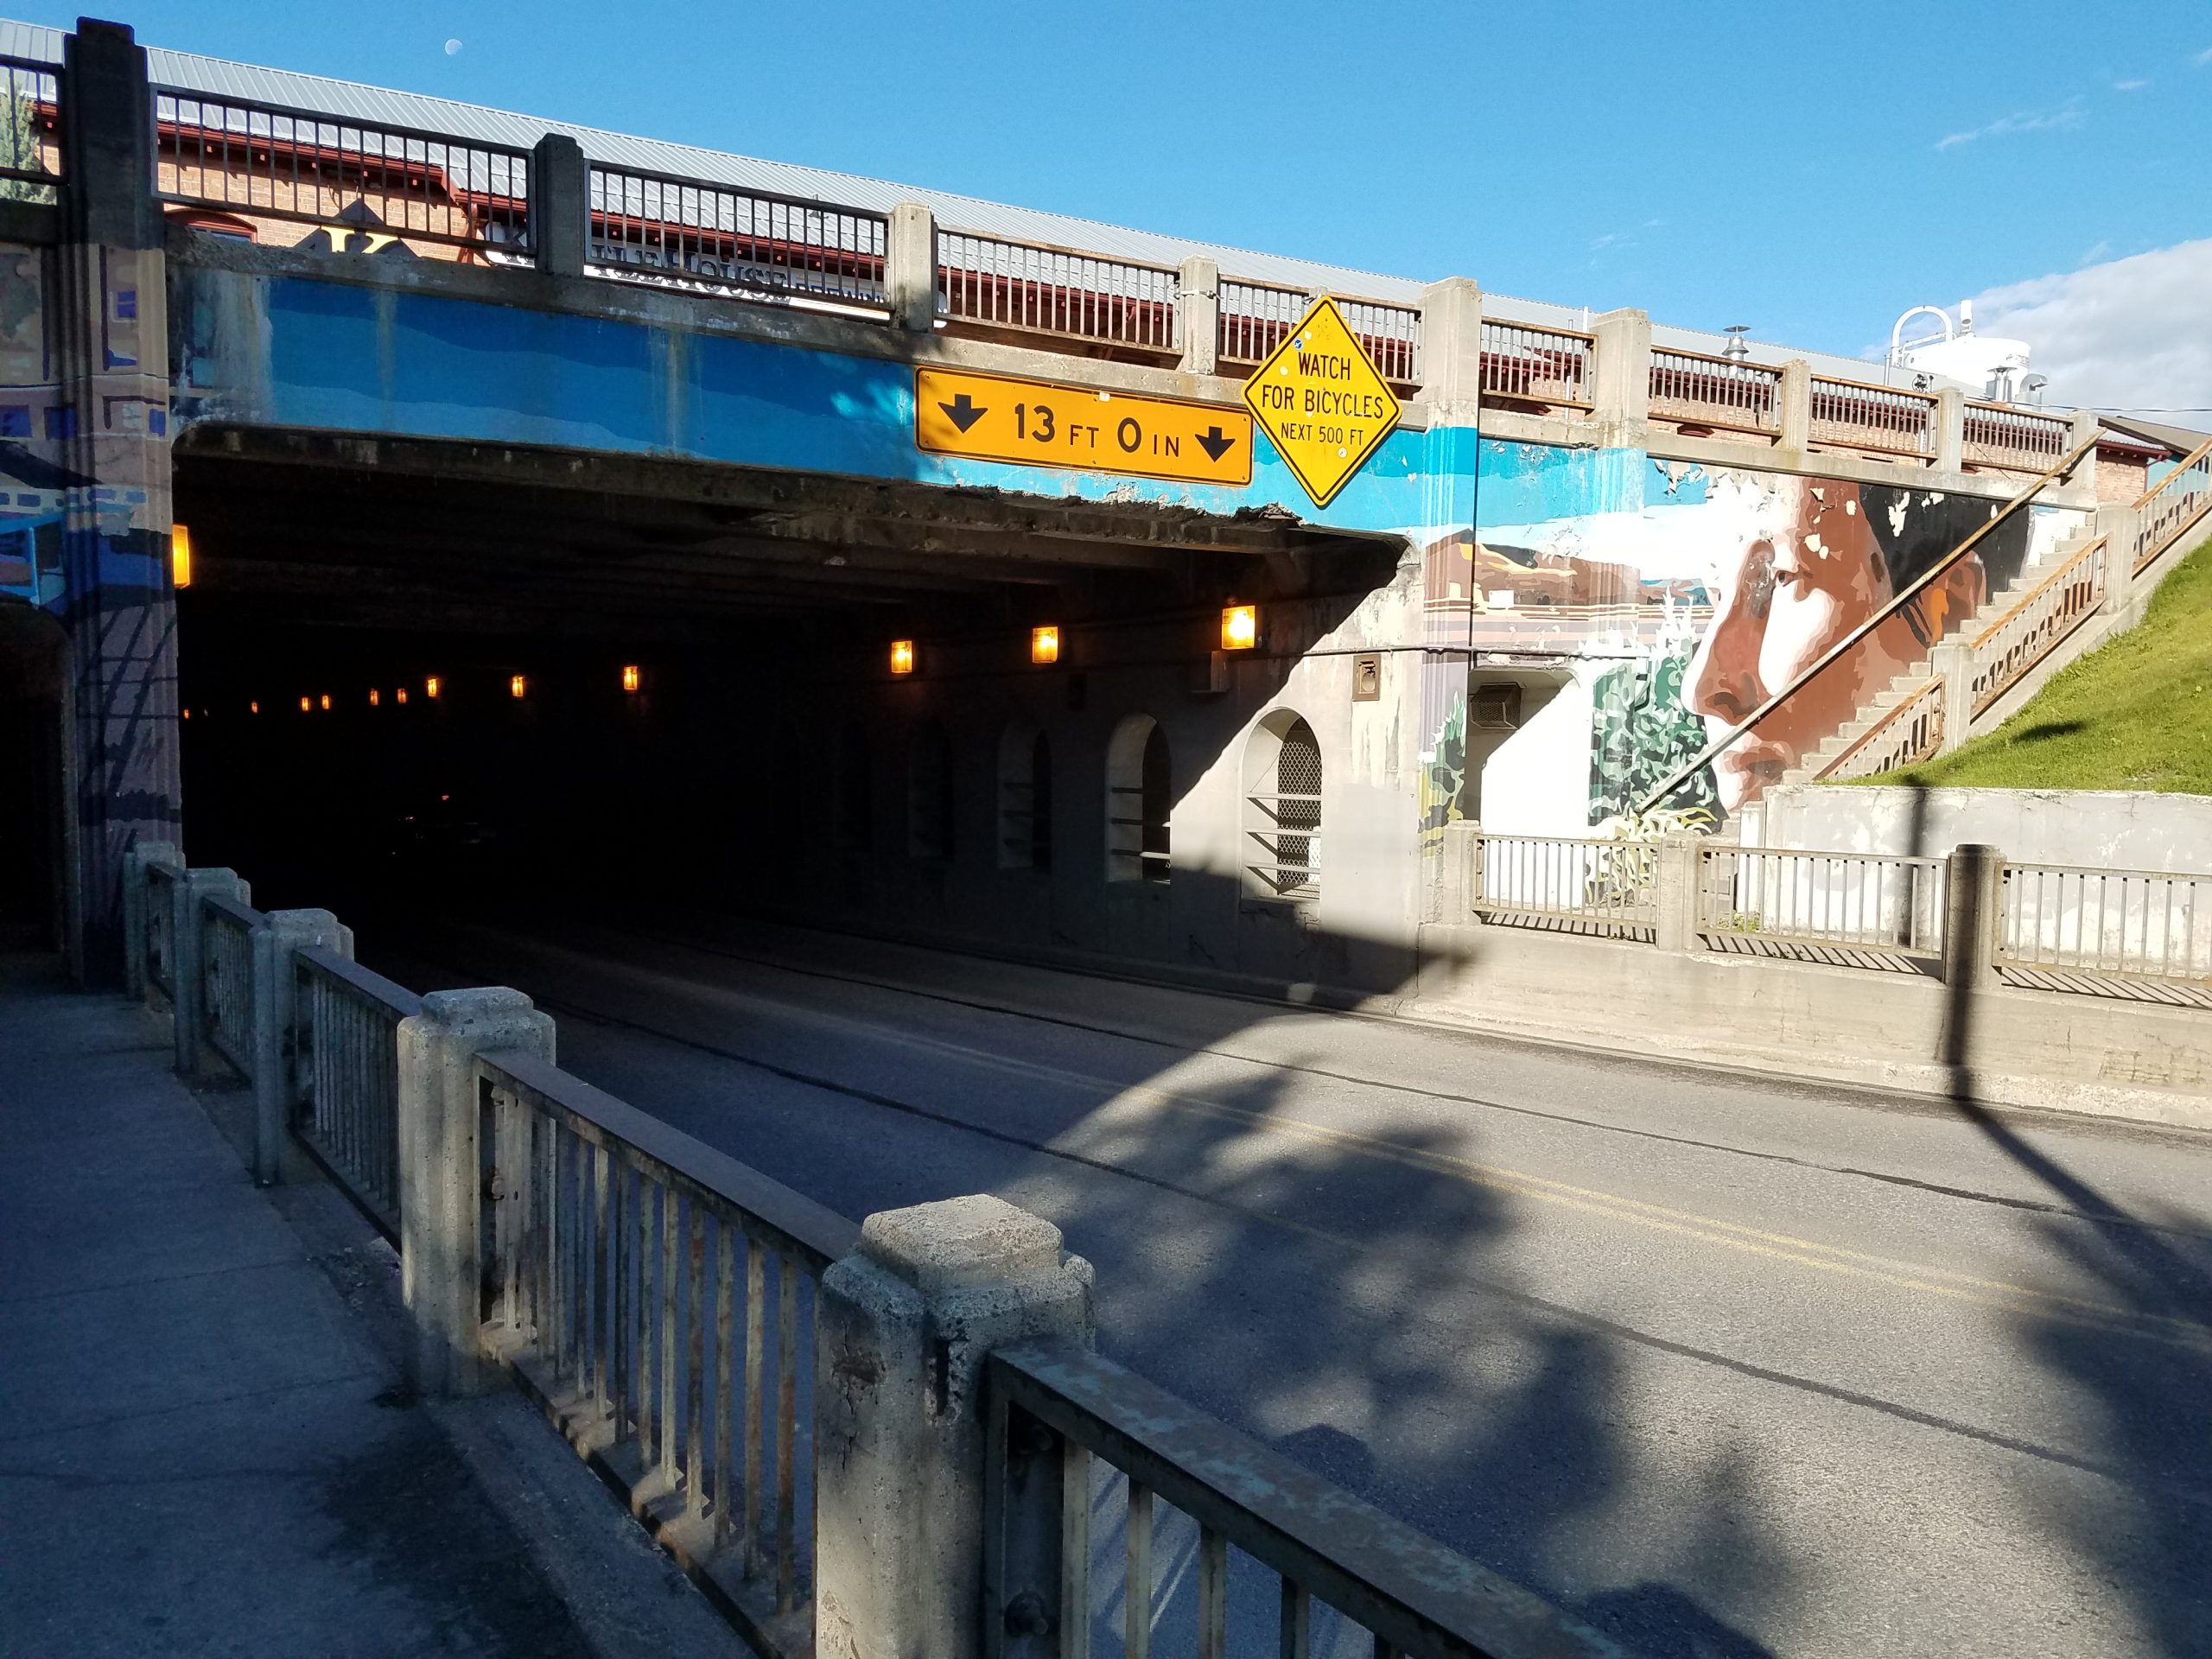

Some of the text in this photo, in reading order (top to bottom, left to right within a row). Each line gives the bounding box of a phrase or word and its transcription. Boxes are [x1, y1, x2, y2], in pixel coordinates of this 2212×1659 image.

[1298, 352, 1351, 380] WATCH
[1262, 385, 1384, 419] FOR BICYCLES
[1014, 402, 1179, 458] 13 FT 0 IN
[1281, 423, 1364, 446] NEXT 500 FT
